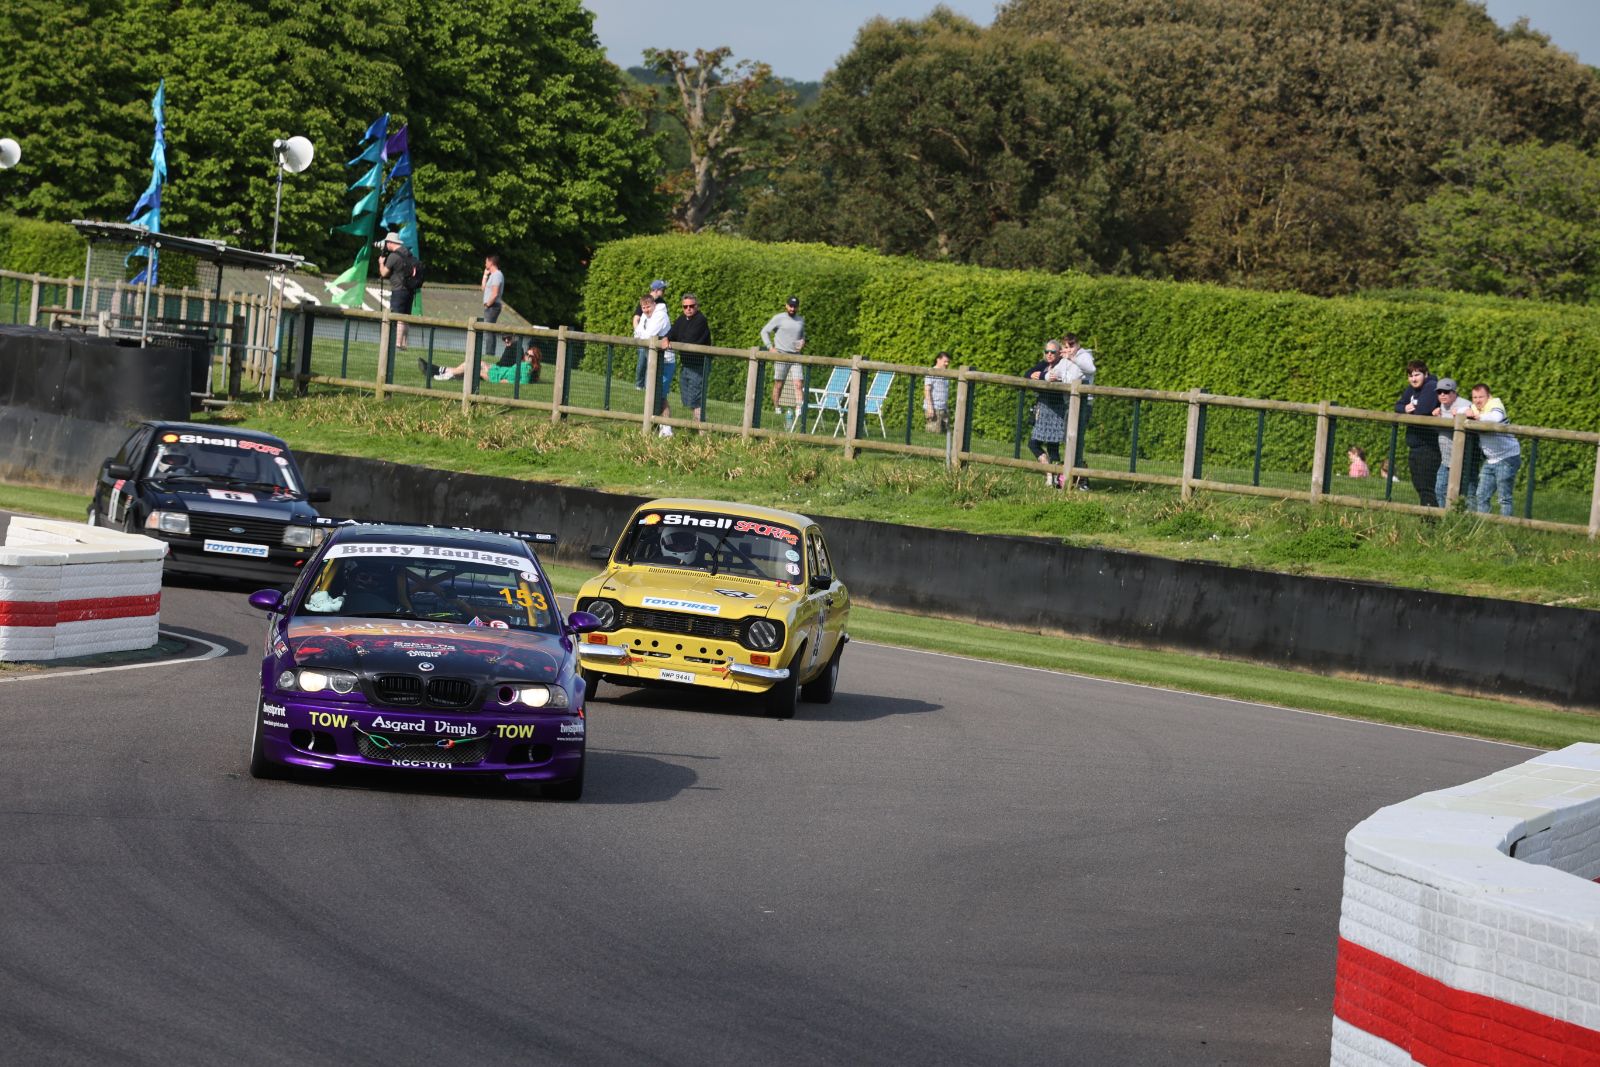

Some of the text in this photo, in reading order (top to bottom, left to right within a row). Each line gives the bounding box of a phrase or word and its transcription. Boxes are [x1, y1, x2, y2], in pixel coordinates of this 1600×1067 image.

[179, 434, 237, 448] Shell
[662, 514, 732, 529] Shell
[206, 543, 266, 555] TOYO TIRES
[342, 545, 520, 566] Burty Haulage
[499, 587, 548, 611] 153
[644, 598, 719, 612] TOYO TIRES
[309, 711, 349, 729] TOW
[371, 715, 478, 737] Asgard Vinyls
[497, 724, 535, 739] TOW
[391, 759, 452, 769] NCC-1701
